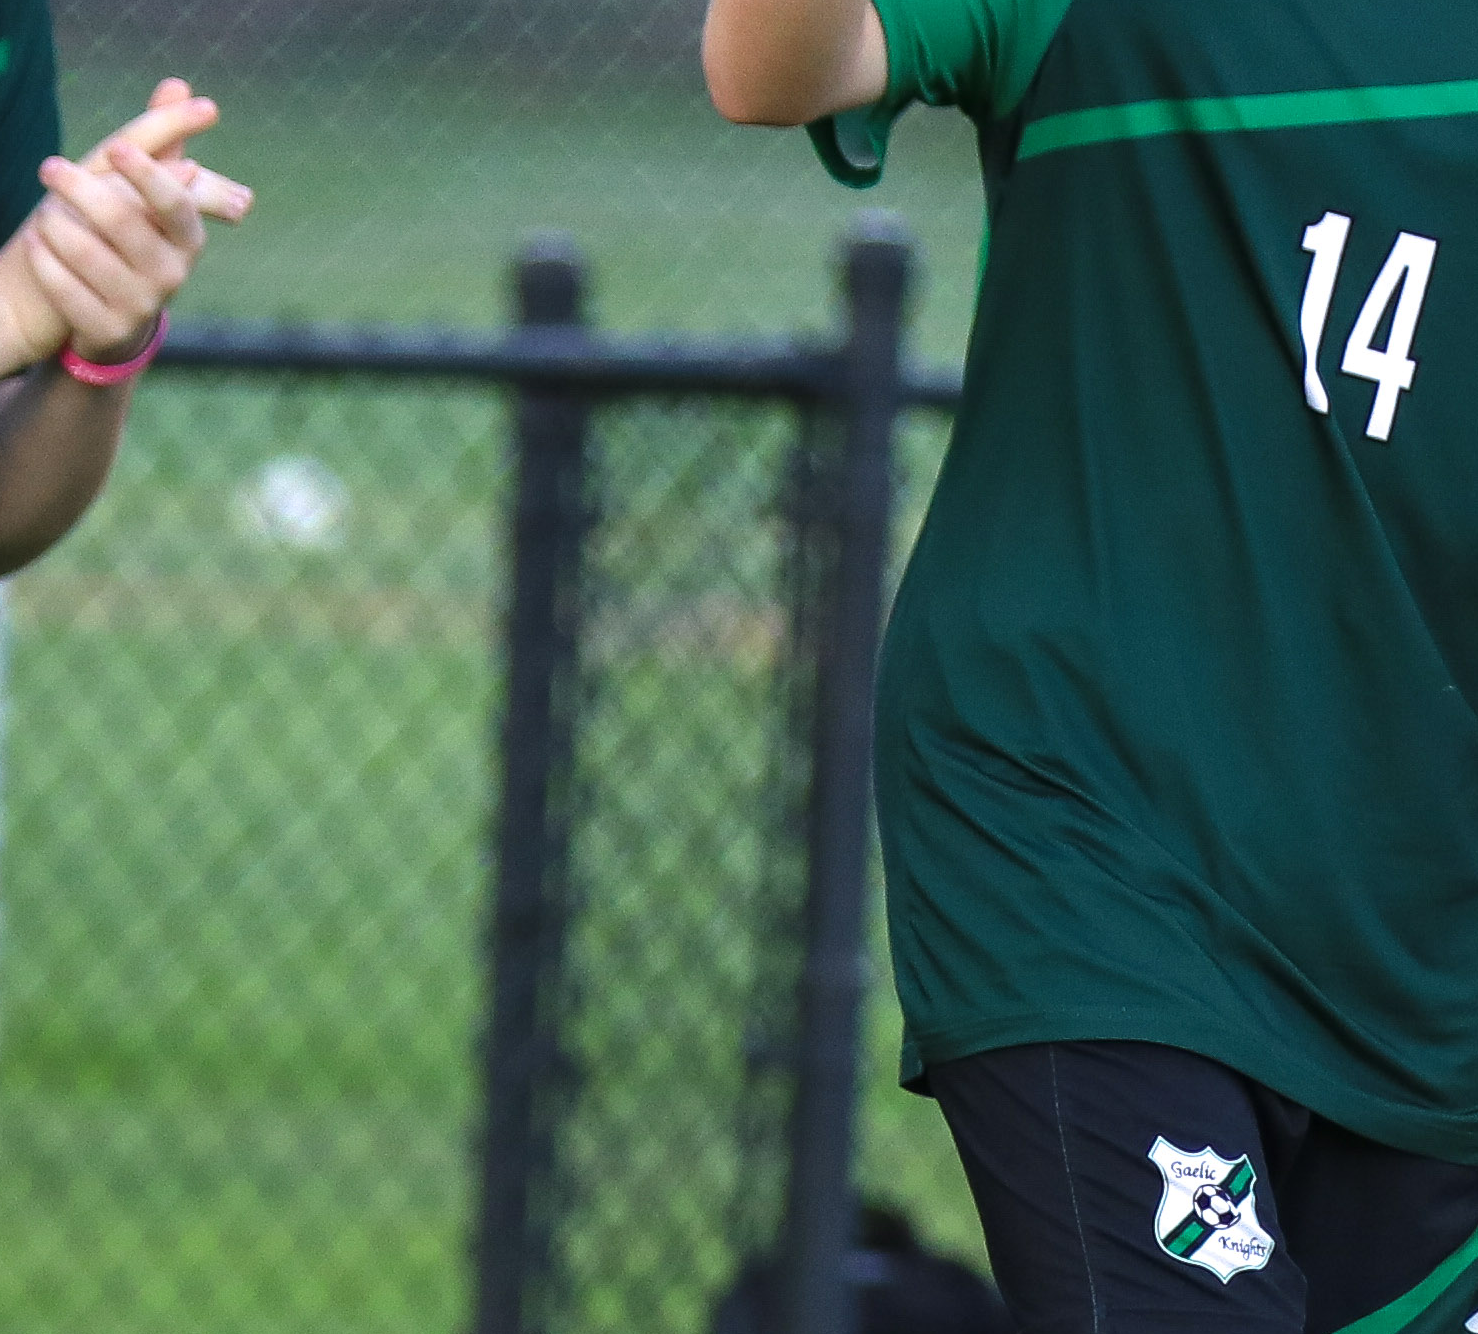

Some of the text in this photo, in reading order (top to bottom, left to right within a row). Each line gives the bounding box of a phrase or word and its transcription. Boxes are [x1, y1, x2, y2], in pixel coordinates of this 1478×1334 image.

[1301, 211, 1437, 441] 14
[1170, 1160, 1216, 1180] Gaelic
[1218, 1235, 1268, 1261] Knights
